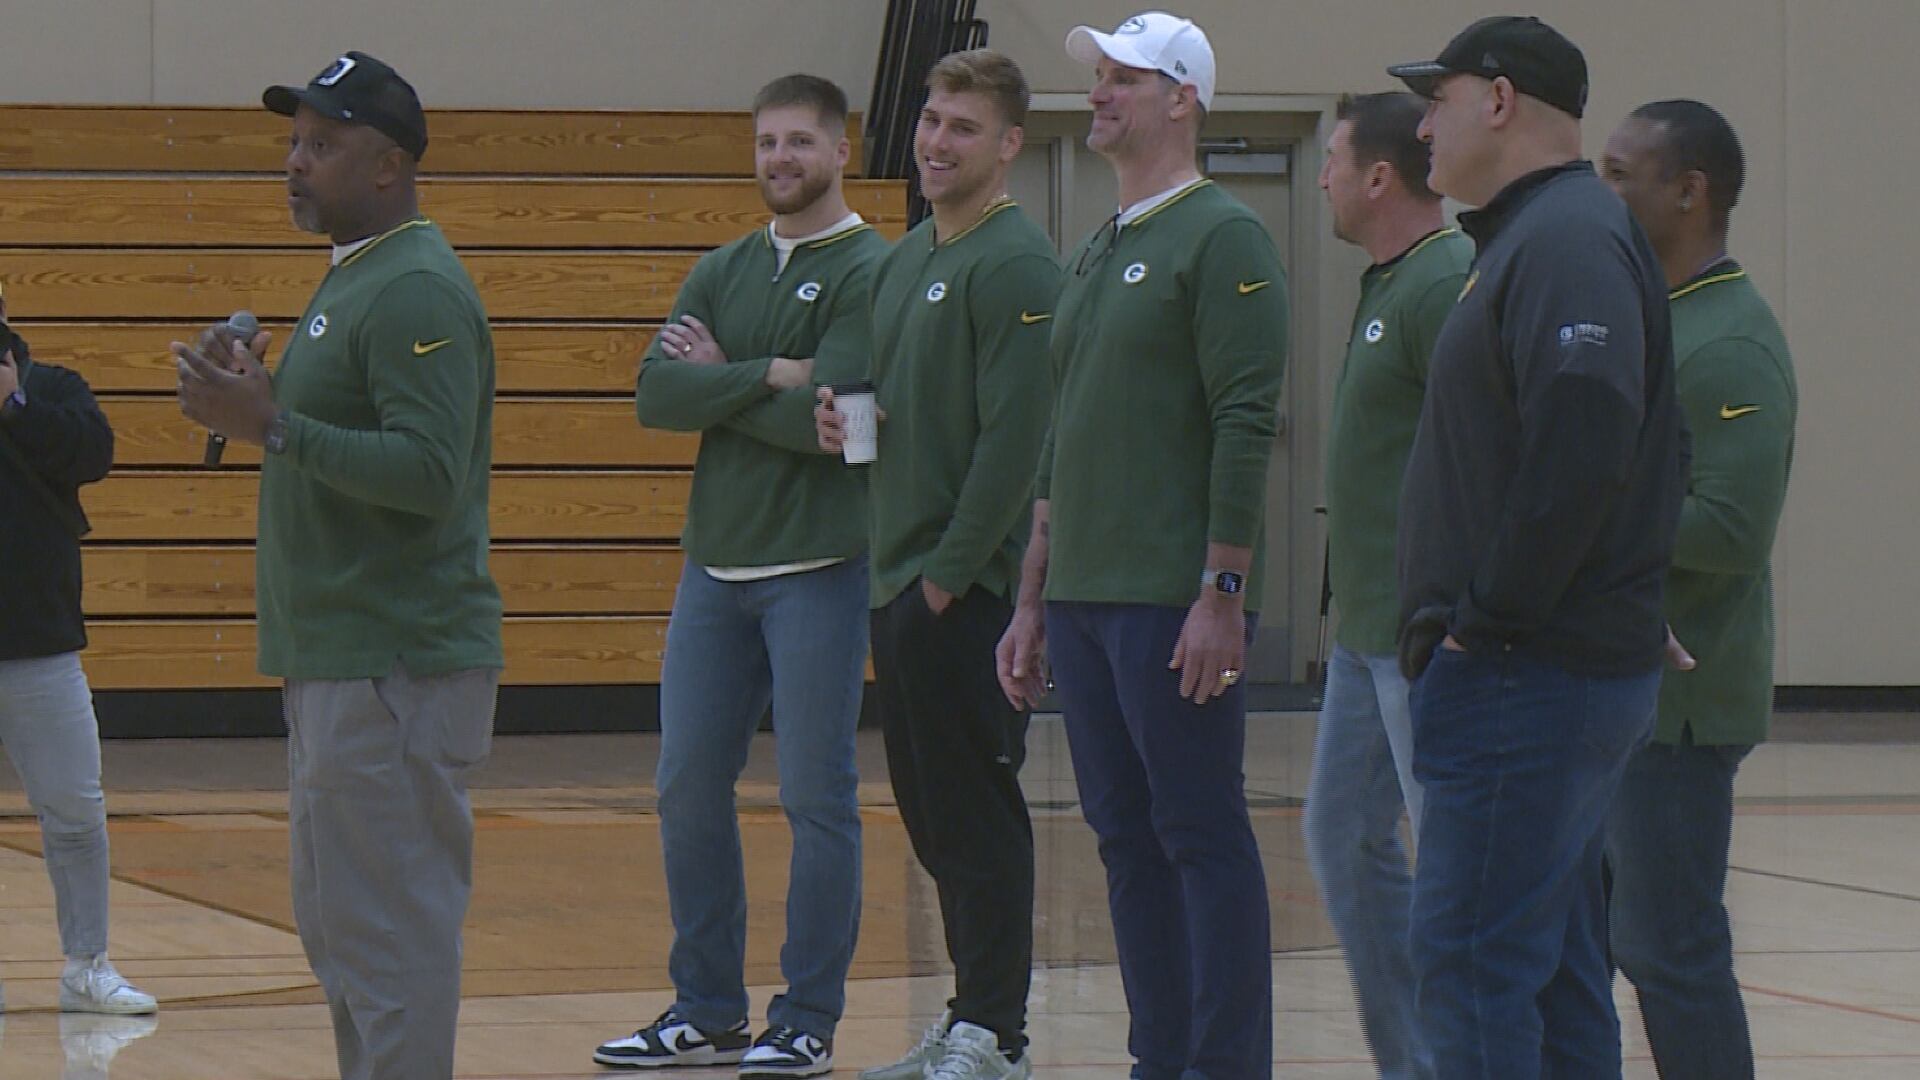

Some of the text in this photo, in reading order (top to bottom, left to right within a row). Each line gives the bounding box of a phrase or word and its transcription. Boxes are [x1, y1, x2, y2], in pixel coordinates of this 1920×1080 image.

[1124, 263, 1147, 283] G
[797, 282, 821, 301] G
[926, 282, 946, 302] G
[310, 314, 328, 337] G
[1365, 319, 1384, 342] G
